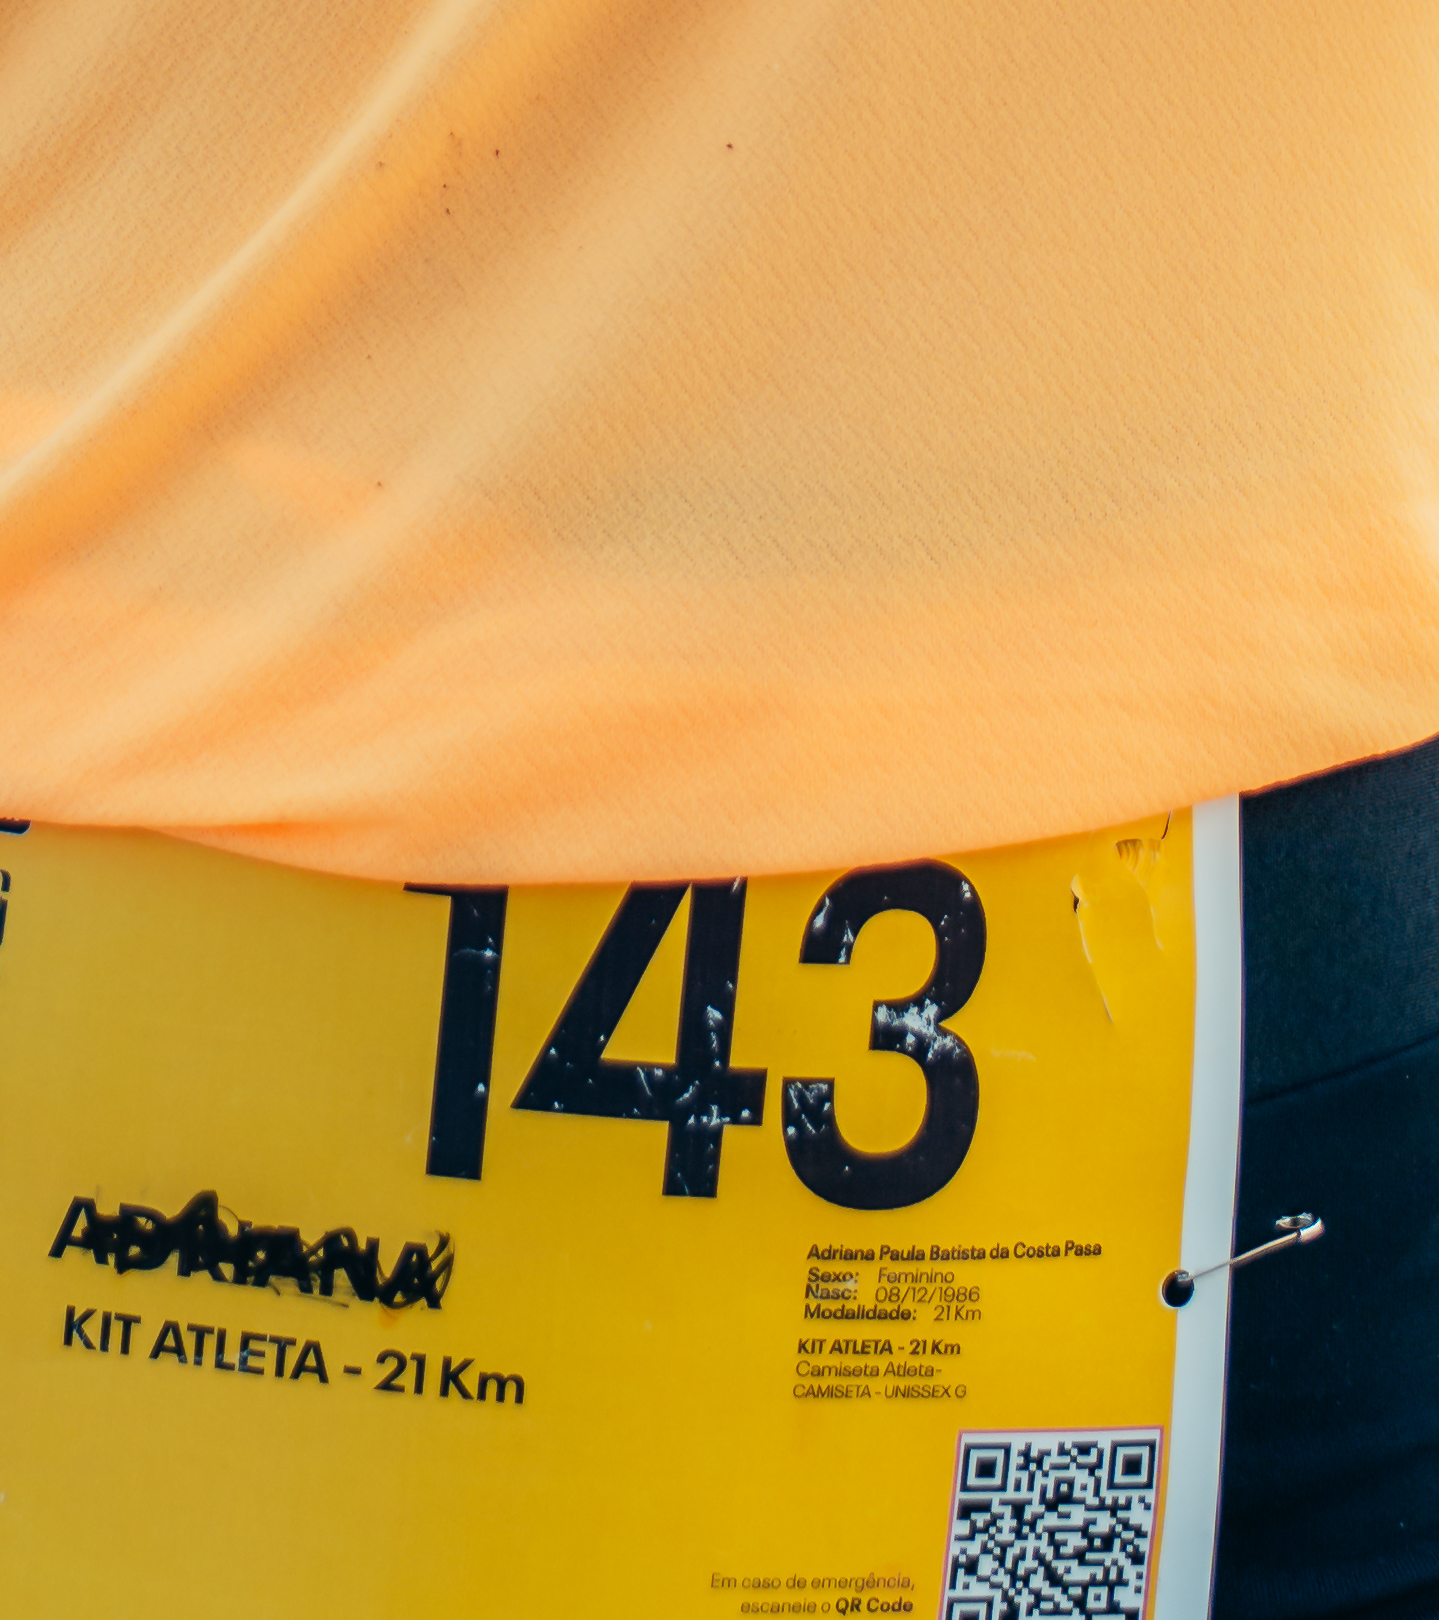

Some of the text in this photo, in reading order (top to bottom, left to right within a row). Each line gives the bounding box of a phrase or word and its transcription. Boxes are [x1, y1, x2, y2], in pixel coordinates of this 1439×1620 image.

[403, 857, 988, 1211] 143
[806, 1243, 875, 1262] Adriana
[879, 1244, 926, 1262] Paula
[929, 1244, 986, 1261] Batista
[989, 1242, 1010, 1260] da
[1013, 1241, 1061, 1259] Costa
[807, 1266, 955, 1284] Sexo: Feminino
[804, 1284, 981, 1304] Nasc: 08/12/1986
[804, 1303, 917, 1321] Modalidade:
[62, 1304, 142, 1355] KIT
[148, 1319, 329, 1384] ATLETA
[797, 1338, 826, 1355] KIT
[829, 1338, 894, 1355] ATLETA
[795, 1360, 880, 1378] Camiseta
[792, 1383, 872, 1399] CAMISETA
[884, 1384, 951, 1399] UNISSEX
[710, 1572, 737, 1590] Em
[740, 1576, 781, 1590] caso
[785, 1573, 807, 1590] de
[740, 1595, 914, 1617] escaneie o QR Code
